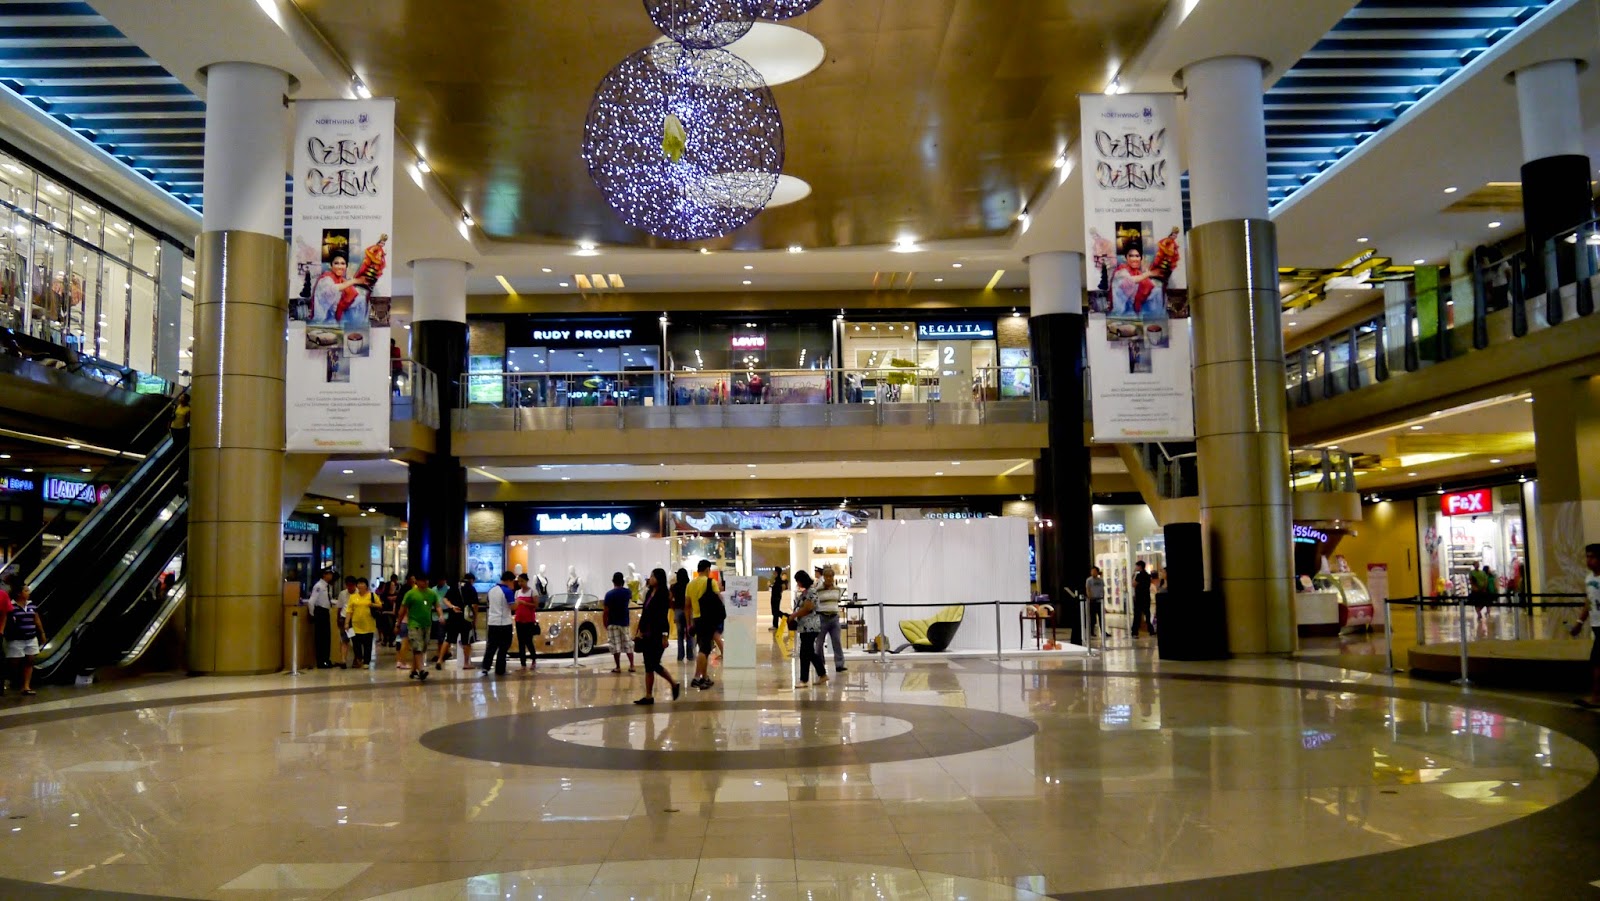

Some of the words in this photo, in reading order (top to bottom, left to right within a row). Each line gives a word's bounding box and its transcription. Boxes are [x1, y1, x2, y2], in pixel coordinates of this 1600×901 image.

[533, 330, 571, 340] RUDY
[575, 329, 632, 340] PROJECT
[919, 324, 981, 335] REGATTA
[943, 346, 955, 365] 2
[1448, 492, 1482, 513] F&X
[1098, 523, 1124, 533] flops
